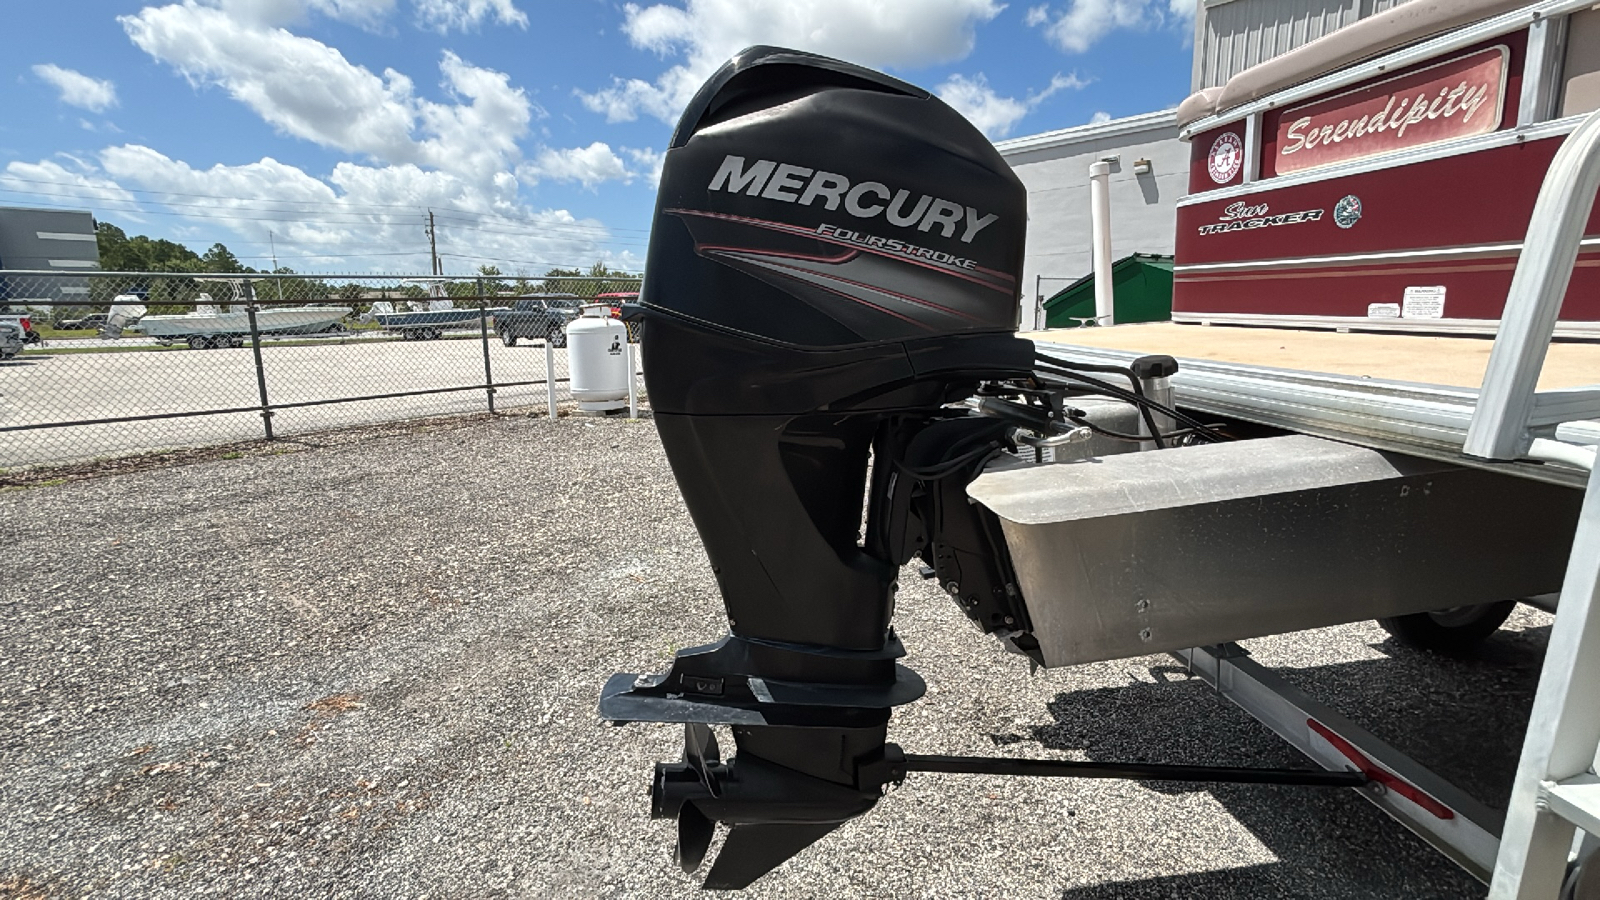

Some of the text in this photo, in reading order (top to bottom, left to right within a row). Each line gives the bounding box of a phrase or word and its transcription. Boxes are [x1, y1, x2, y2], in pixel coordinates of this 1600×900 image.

[1281, 81, 1487, 155] Serendipity
[708, 155, 999, 244] MERCURY
[1198, 209, 1324, 235] TRACKER
[1219, 201, 1269, 221] Sun
[816, 223, 977, 270] FOURSTROKE
